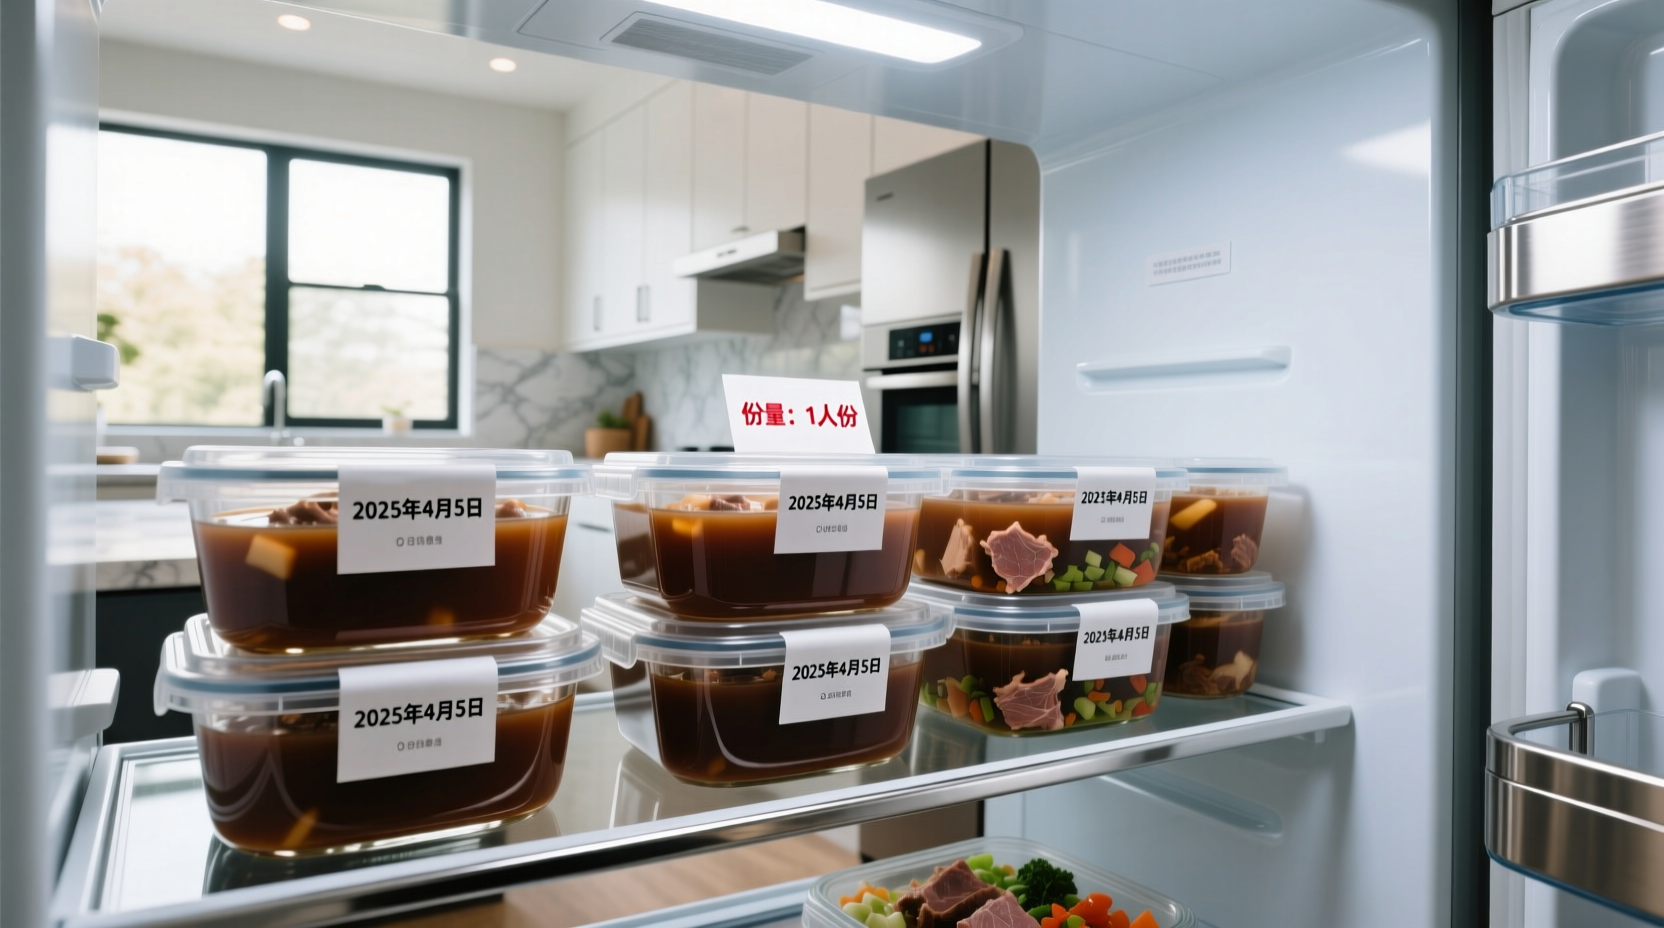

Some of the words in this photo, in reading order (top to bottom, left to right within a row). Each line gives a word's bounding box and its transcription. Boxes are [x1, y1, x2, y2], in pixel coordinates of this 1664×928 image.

[741, 401, 858, 428] 份量：1人份
[352, 497, 482, 521] 2025年4月5日
[788, 492, 878, 512] 2025年4月5日
[791, 657, 881, 681] 2025年4月5日
[353, 697, 484, 728] 2025年4月5日
